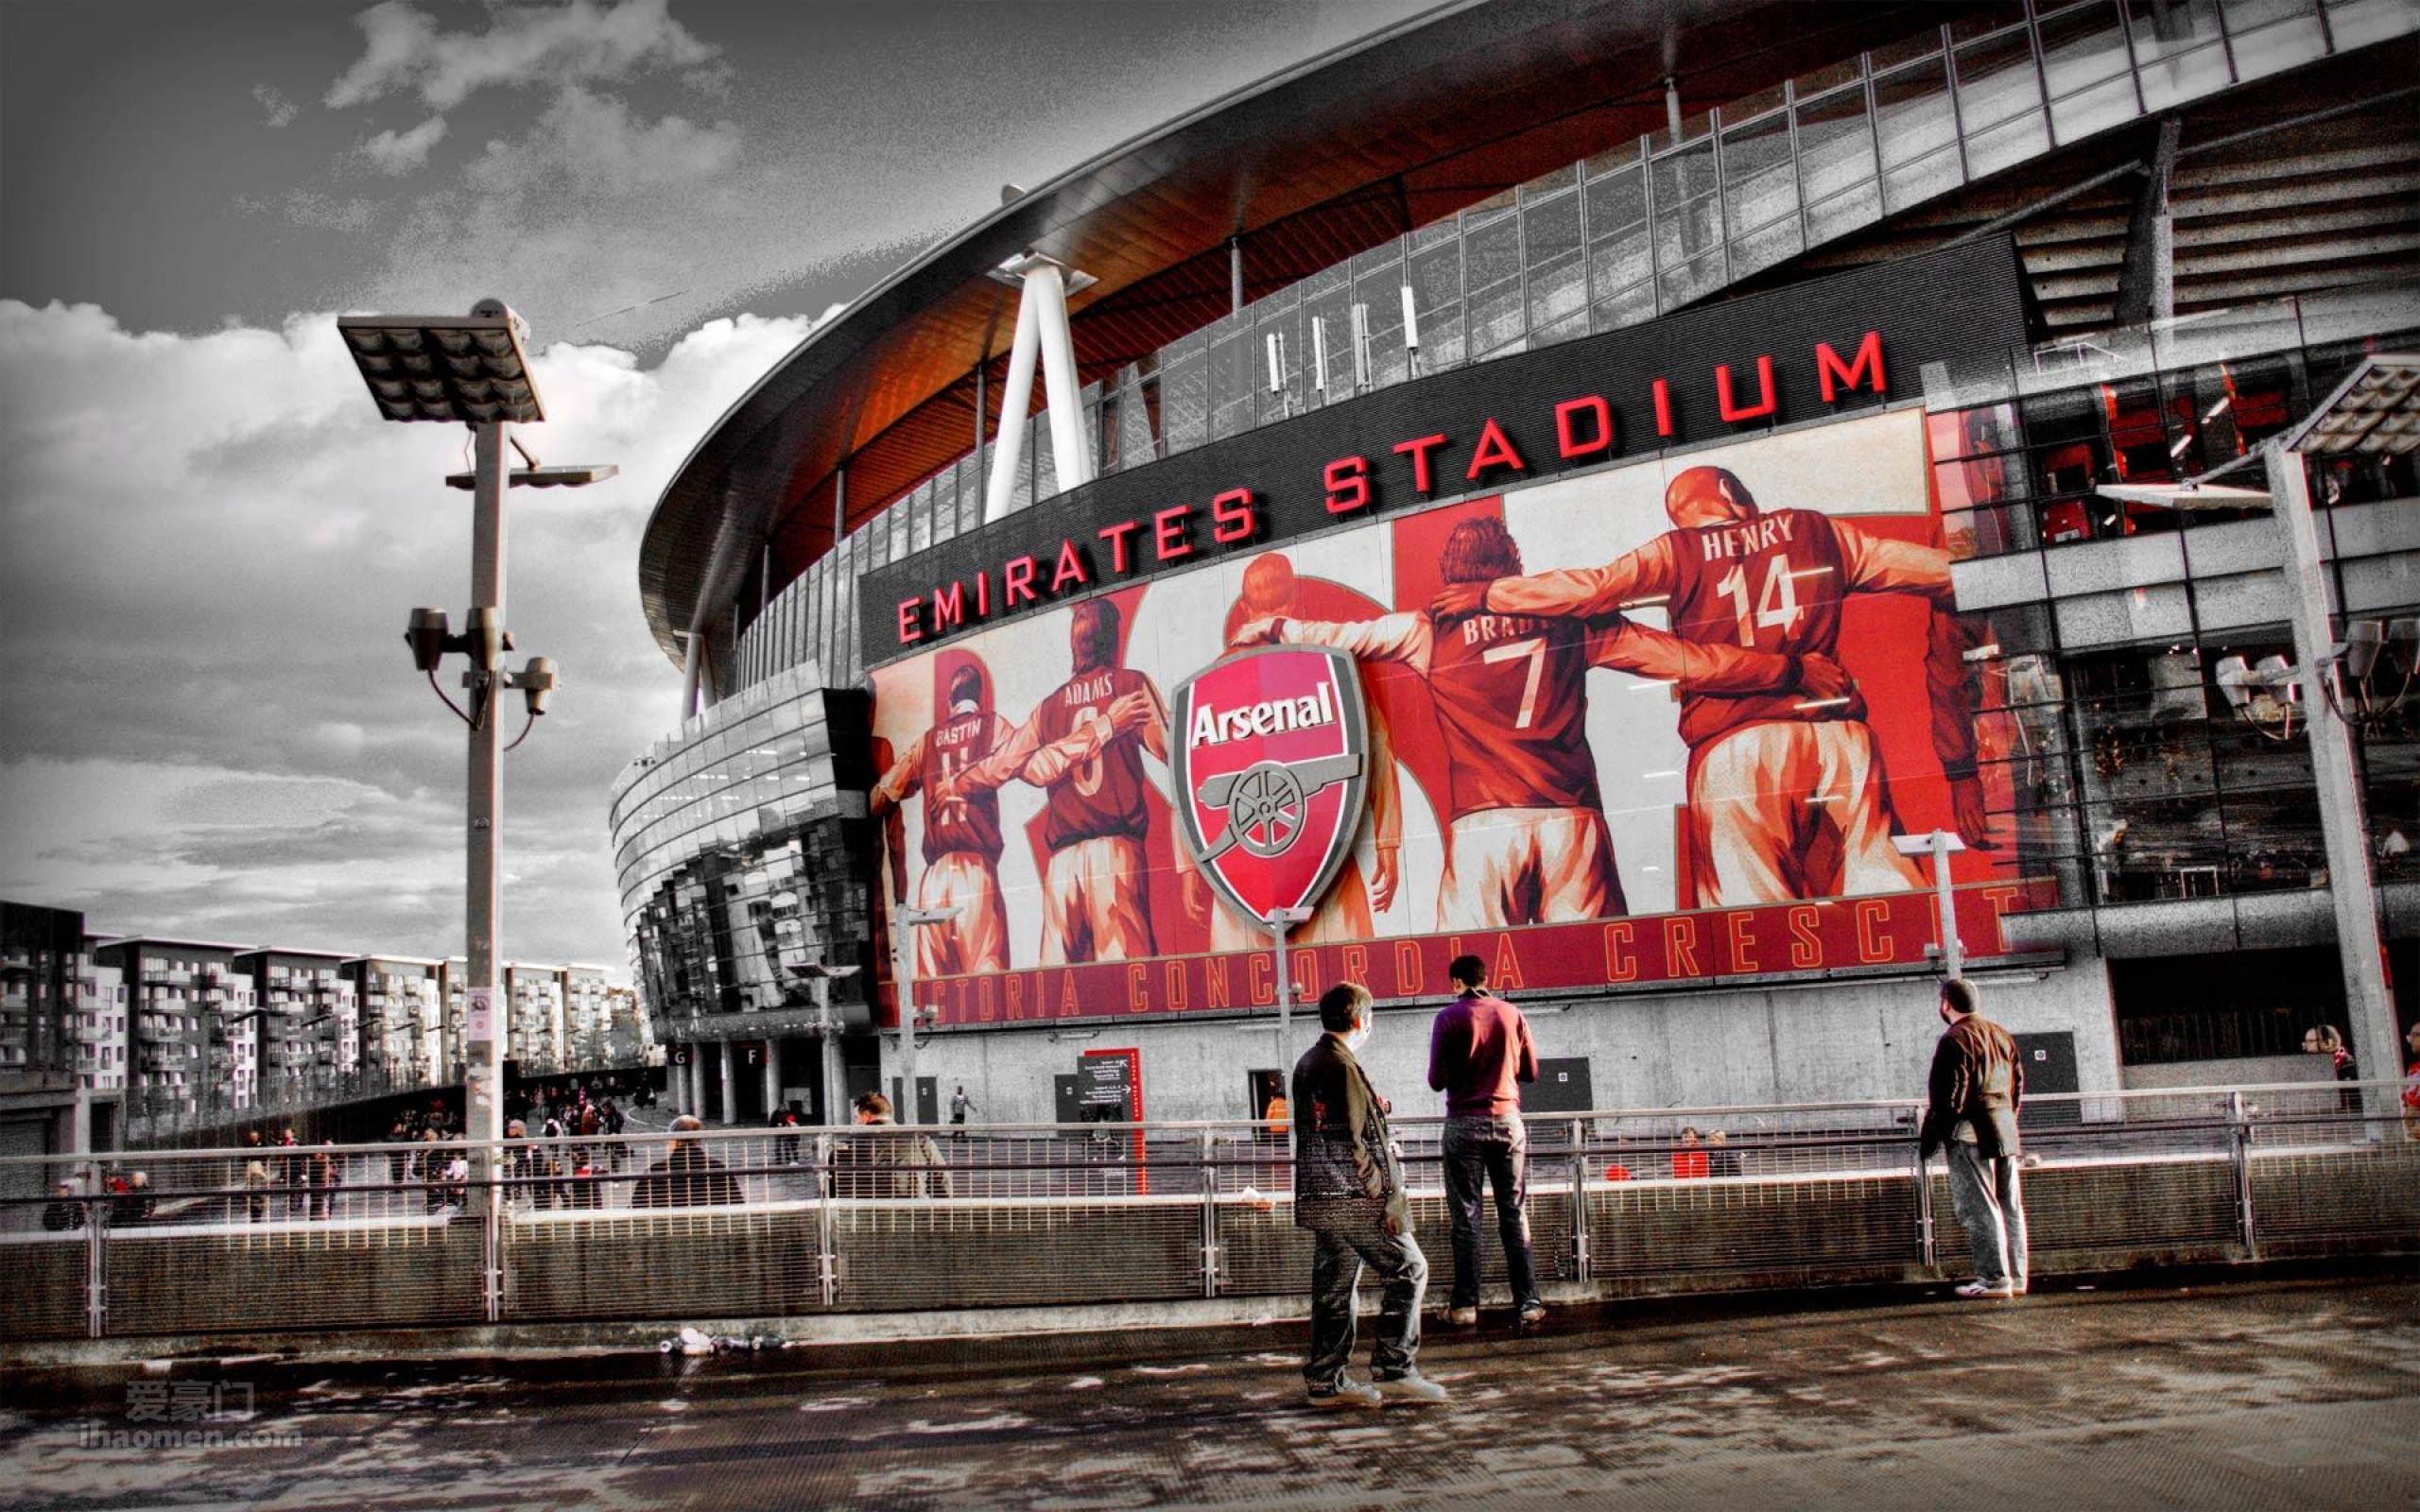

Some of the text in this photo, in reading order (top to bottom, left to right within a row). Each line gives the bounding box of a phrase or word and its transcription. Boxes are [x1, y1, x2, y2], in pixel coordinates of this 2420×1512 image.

[897, 330, 1887, 645] EMIRATES STADIUM
[1702, 513, 1794, 562] HENRY
[1716, 554, 1805, 648] 14
[1064, 672, 1114, 707] ADAMS
[1482, 637, 1547, 730] 7
[935, 718, 982, 747] BASTIN
[1191, 680, 1335, 749] Arsenal
[674, 1051, 685, 1065] G
[748, 1049, 757, 1065] F
